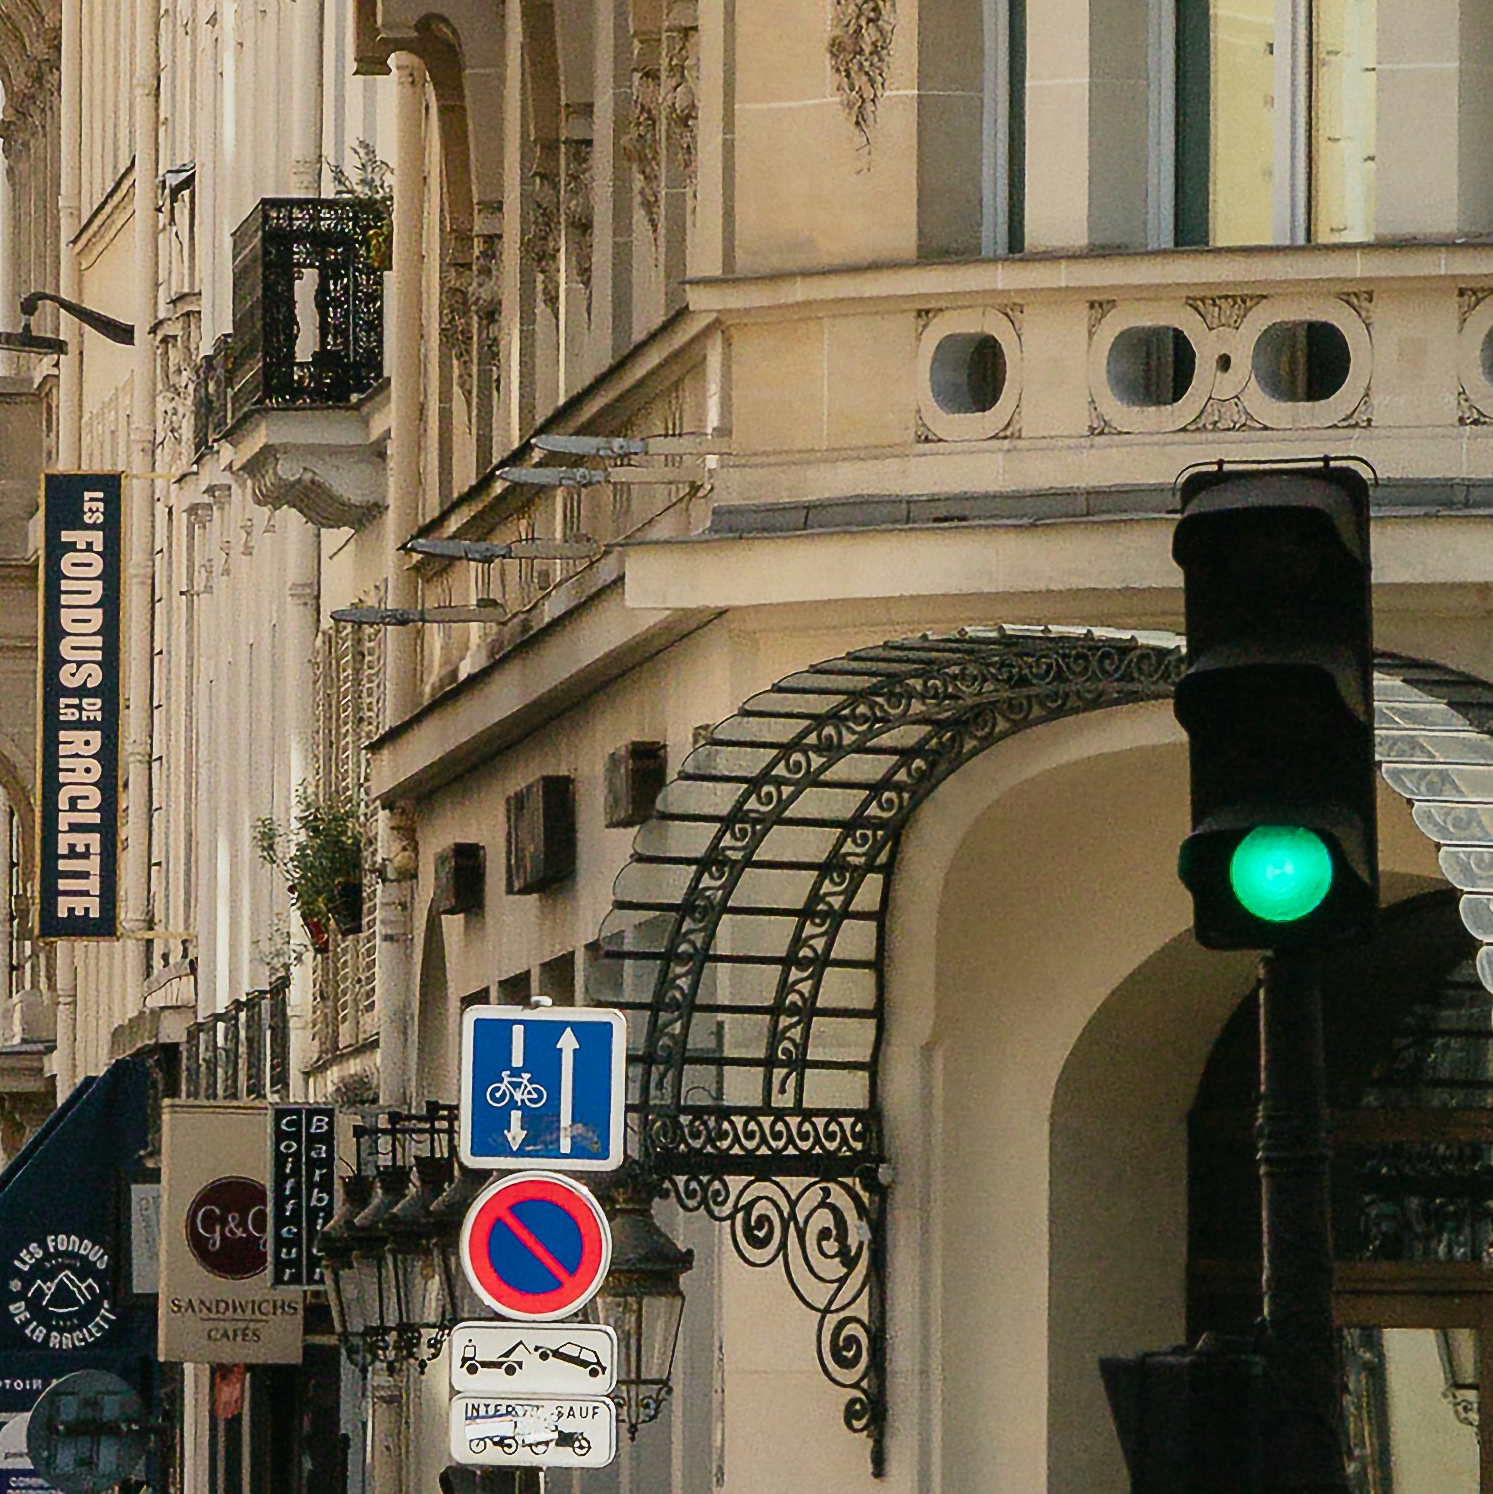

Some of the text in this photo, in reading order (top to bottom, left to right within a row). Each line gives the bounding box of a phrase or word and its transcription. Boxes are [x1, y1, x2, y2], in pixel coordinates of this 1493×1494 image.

[57, 491, 104, 918] LES FONDUS DE LA RACLETTE
[279, 1115, 298, 1282] Coiffeur
[13, 1242, 43, 1272] LES
[169, 1297, 299, 1315] SANDWICHS
[8, 1299, 117, 1350] DE LA RACLETT
[206, 1324, 262, 1344] CAFÉS
[555, 1404, 600, 1420] SAUF
